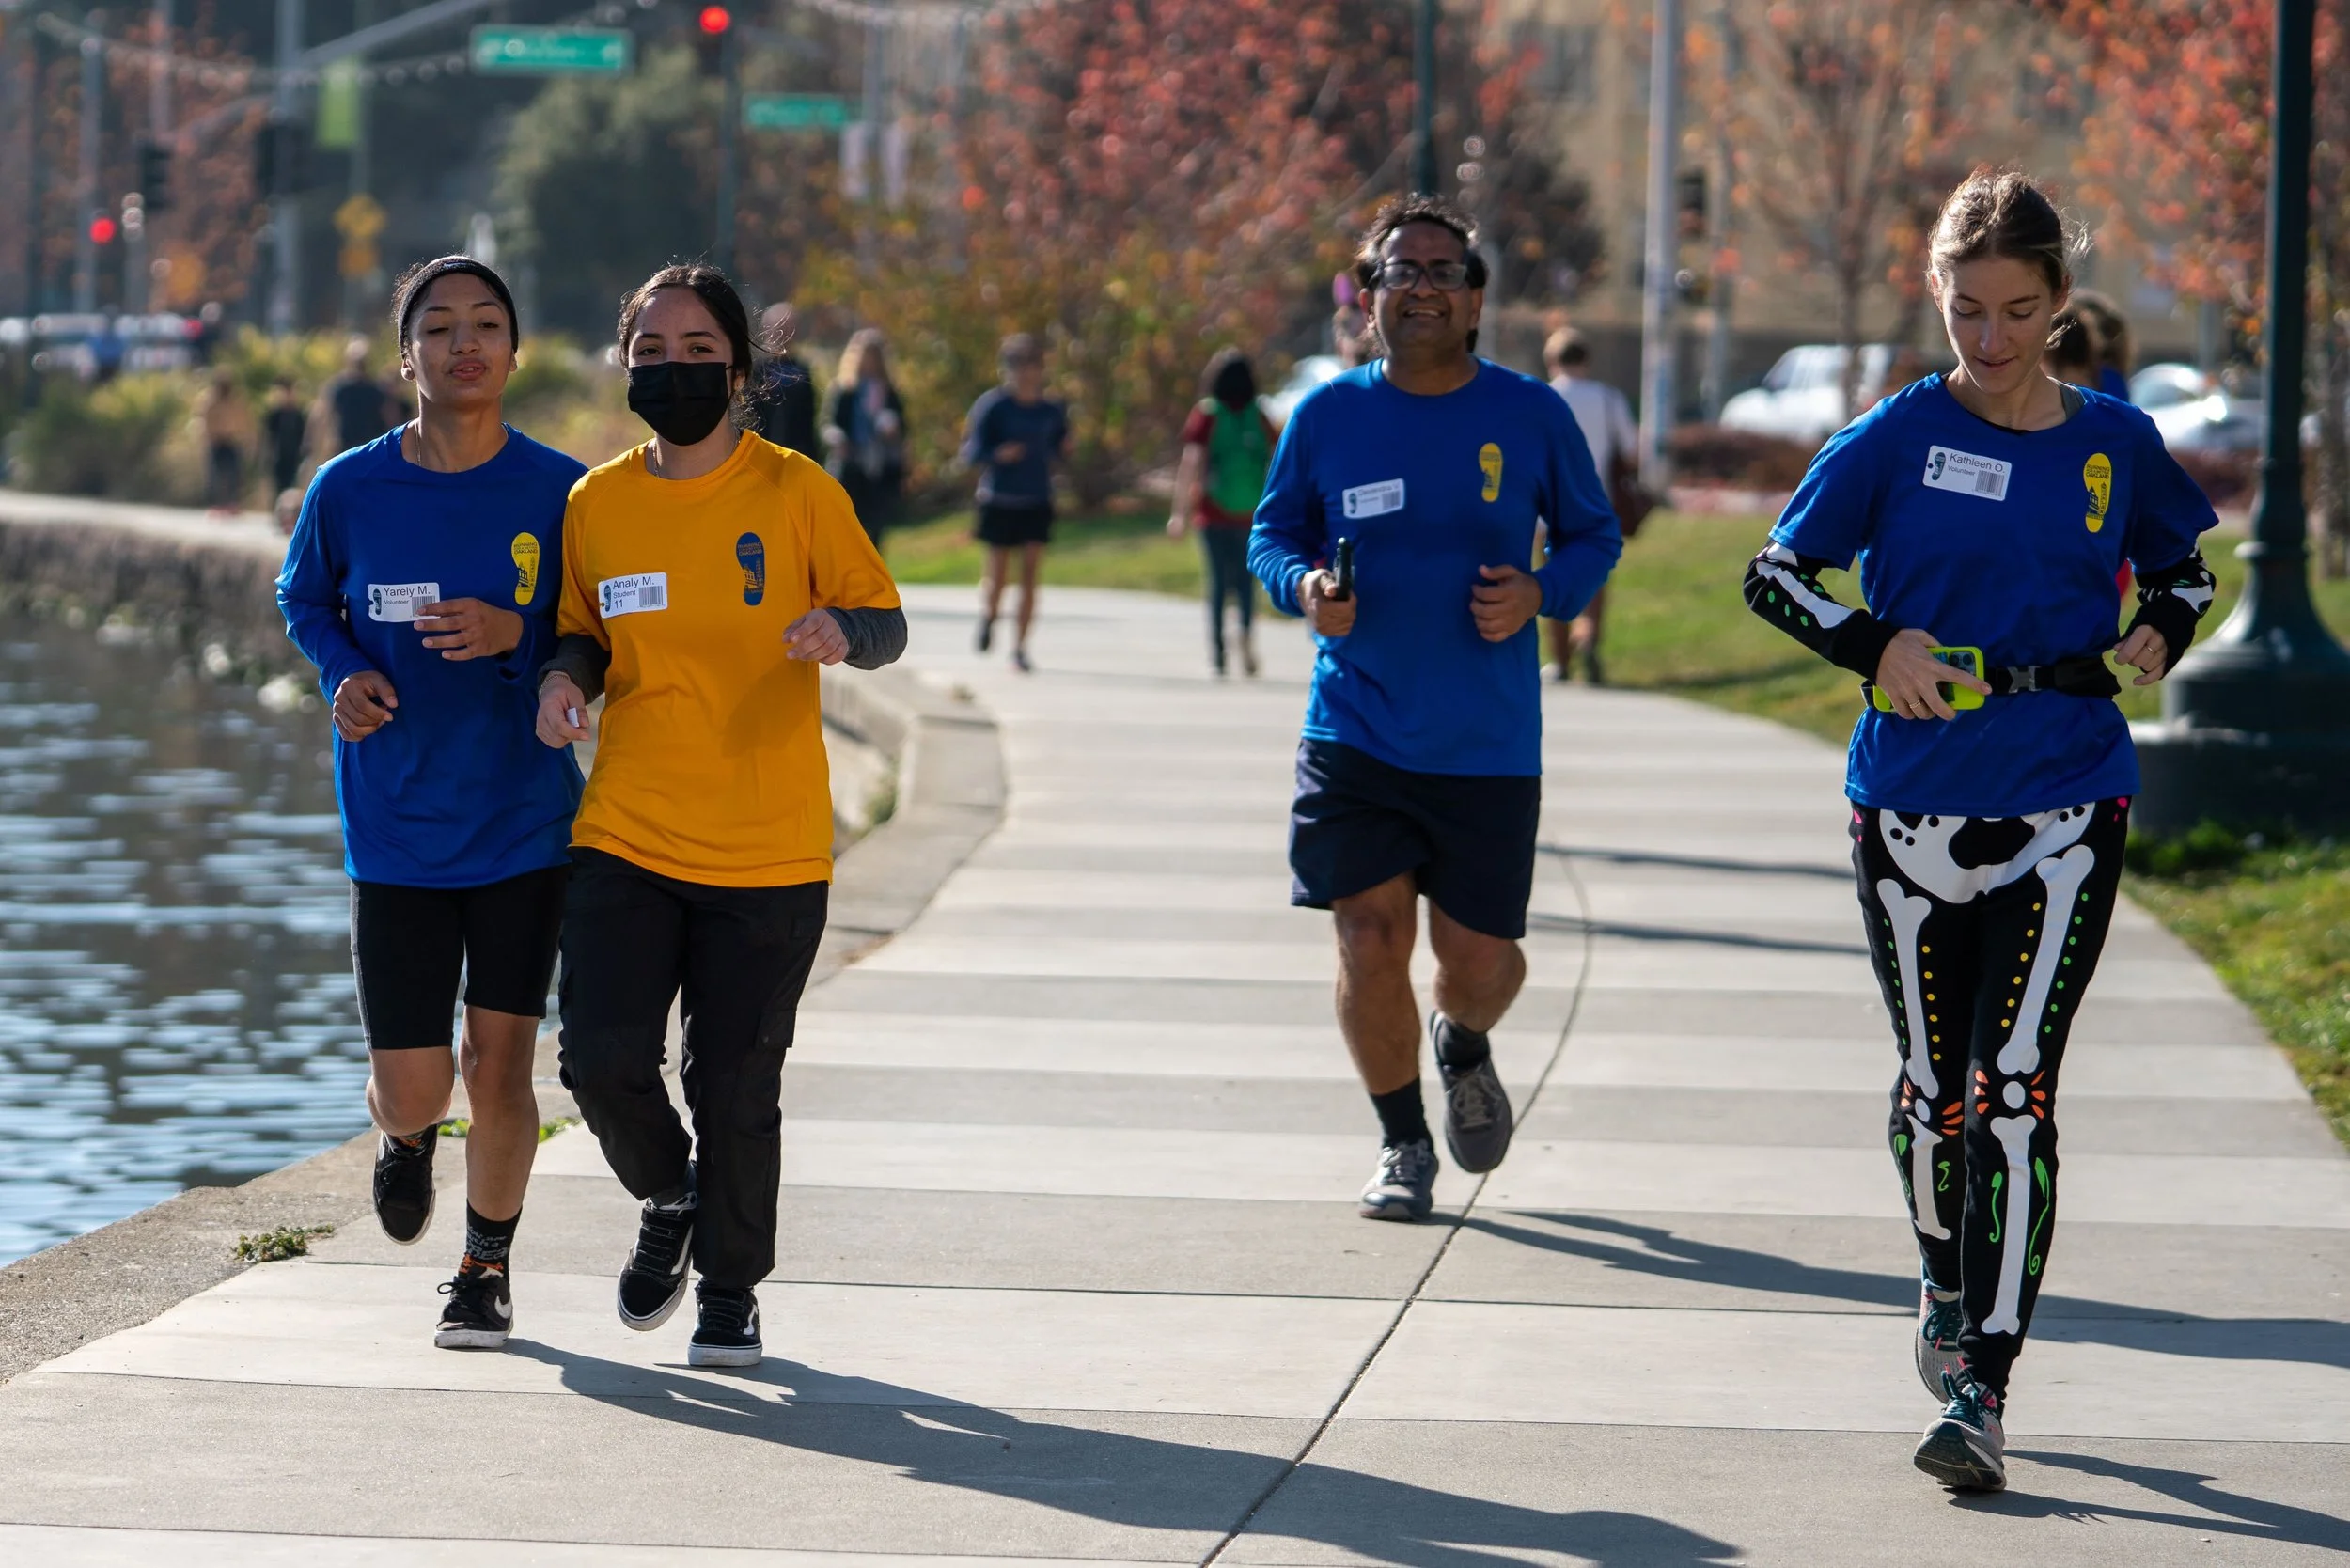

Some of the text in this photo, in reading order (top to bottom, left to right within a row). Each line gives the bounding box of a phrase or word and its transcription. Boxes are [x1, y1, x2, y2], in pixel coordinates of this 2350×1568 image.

[1949, 452, 1992, 470] Kathleen
[1948, 464, 1976, 476] Volunteer
[612, 575, 655, 590] Analy M.
[383, 585, 431, 598] Yarely M.
[613, 589, 636, 599] Student
[615, 599, 623, 609] 11
